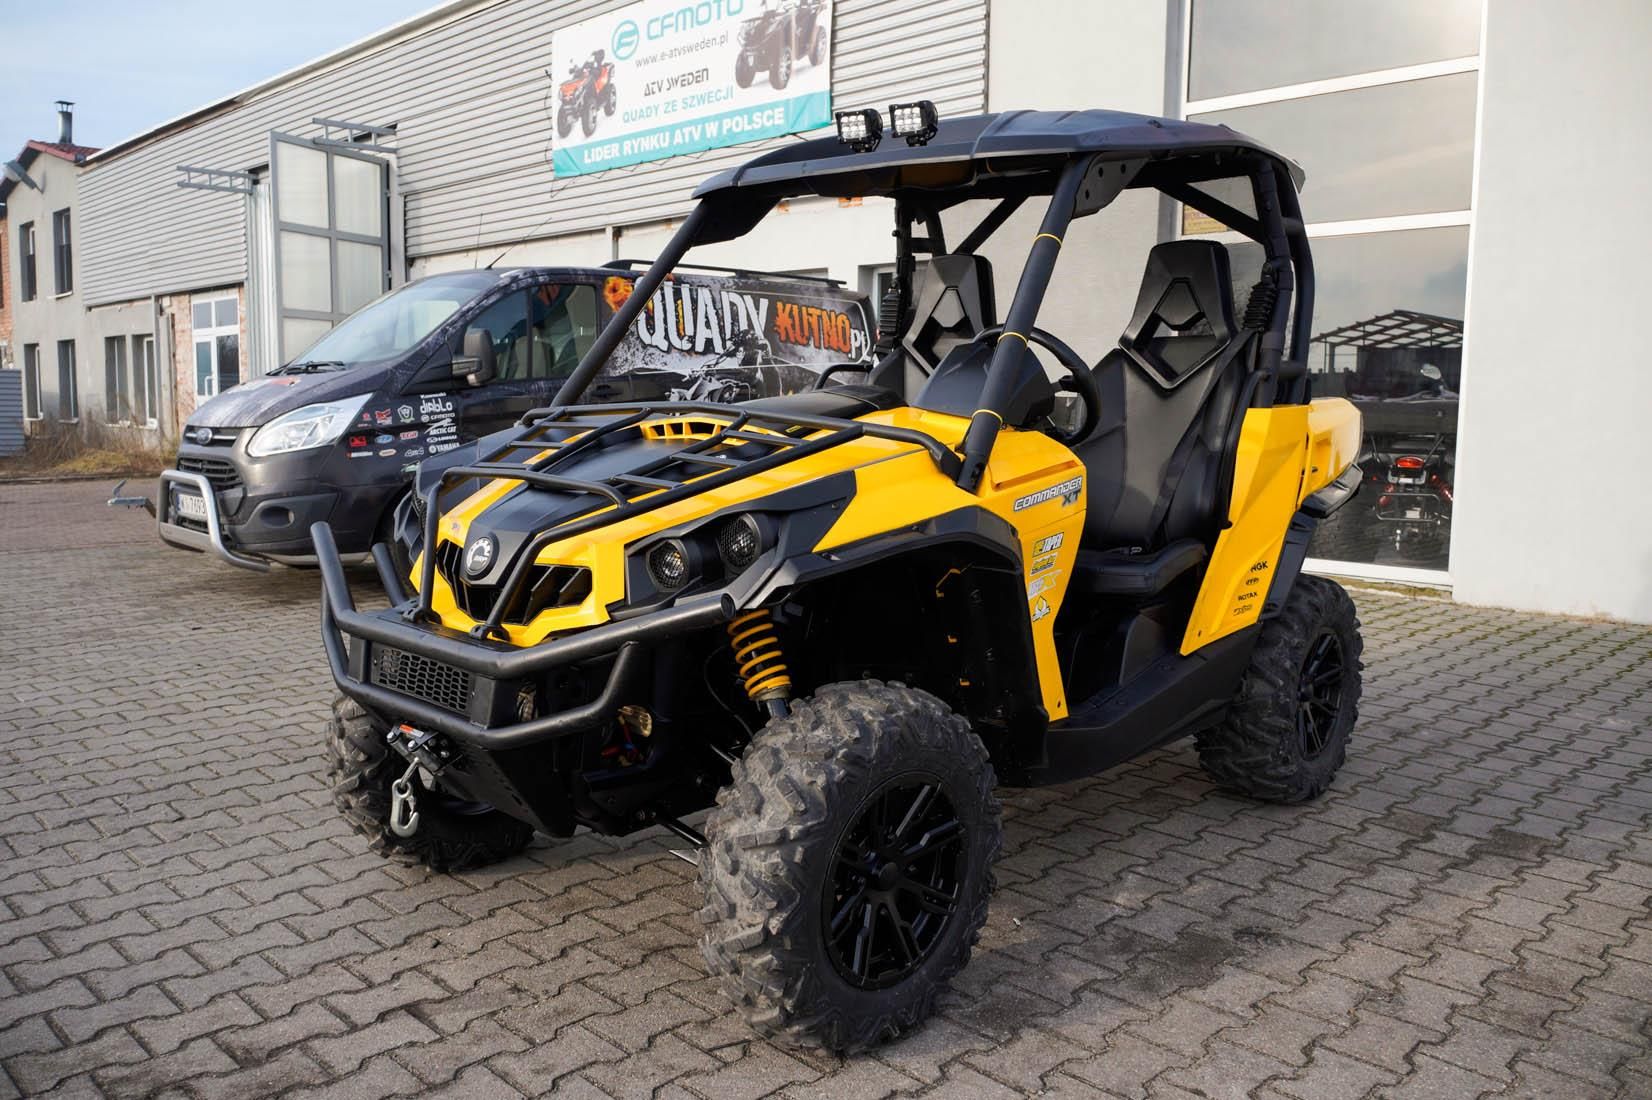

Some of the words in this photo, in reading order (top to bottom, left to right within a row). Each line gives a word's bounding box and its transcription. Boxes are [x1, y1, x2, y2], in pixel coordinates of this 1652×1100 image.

[647, 0, 744, 40] CFMOTO
[635, 31, 729, 68] www.e-atvsweden.pl
[644, 79, 664, 97] ATV
[666, 68, 709, 91] SWEDEN
[622, 103, 660, 123] QUADY
[664, 99, 678, 114] ZE
[681, 85, 734, 110] SZWECJI
[584, 143, 620, 163] LIDER
[623, 131, 669, 156] RYNKU
[673, 124, 702, 145] ATV
[704, 122, 720, 138] W
[723, 107, 785, 135] POLSCE
[636, 277, 769, 355] QUADY
[436, 442, 460, 453] YAMAHA
[1014, 475, 1083, 511] COMMANDER
[1062, 489, 1081, 507] XT
[1250, 561, 1268, 573] NGK
